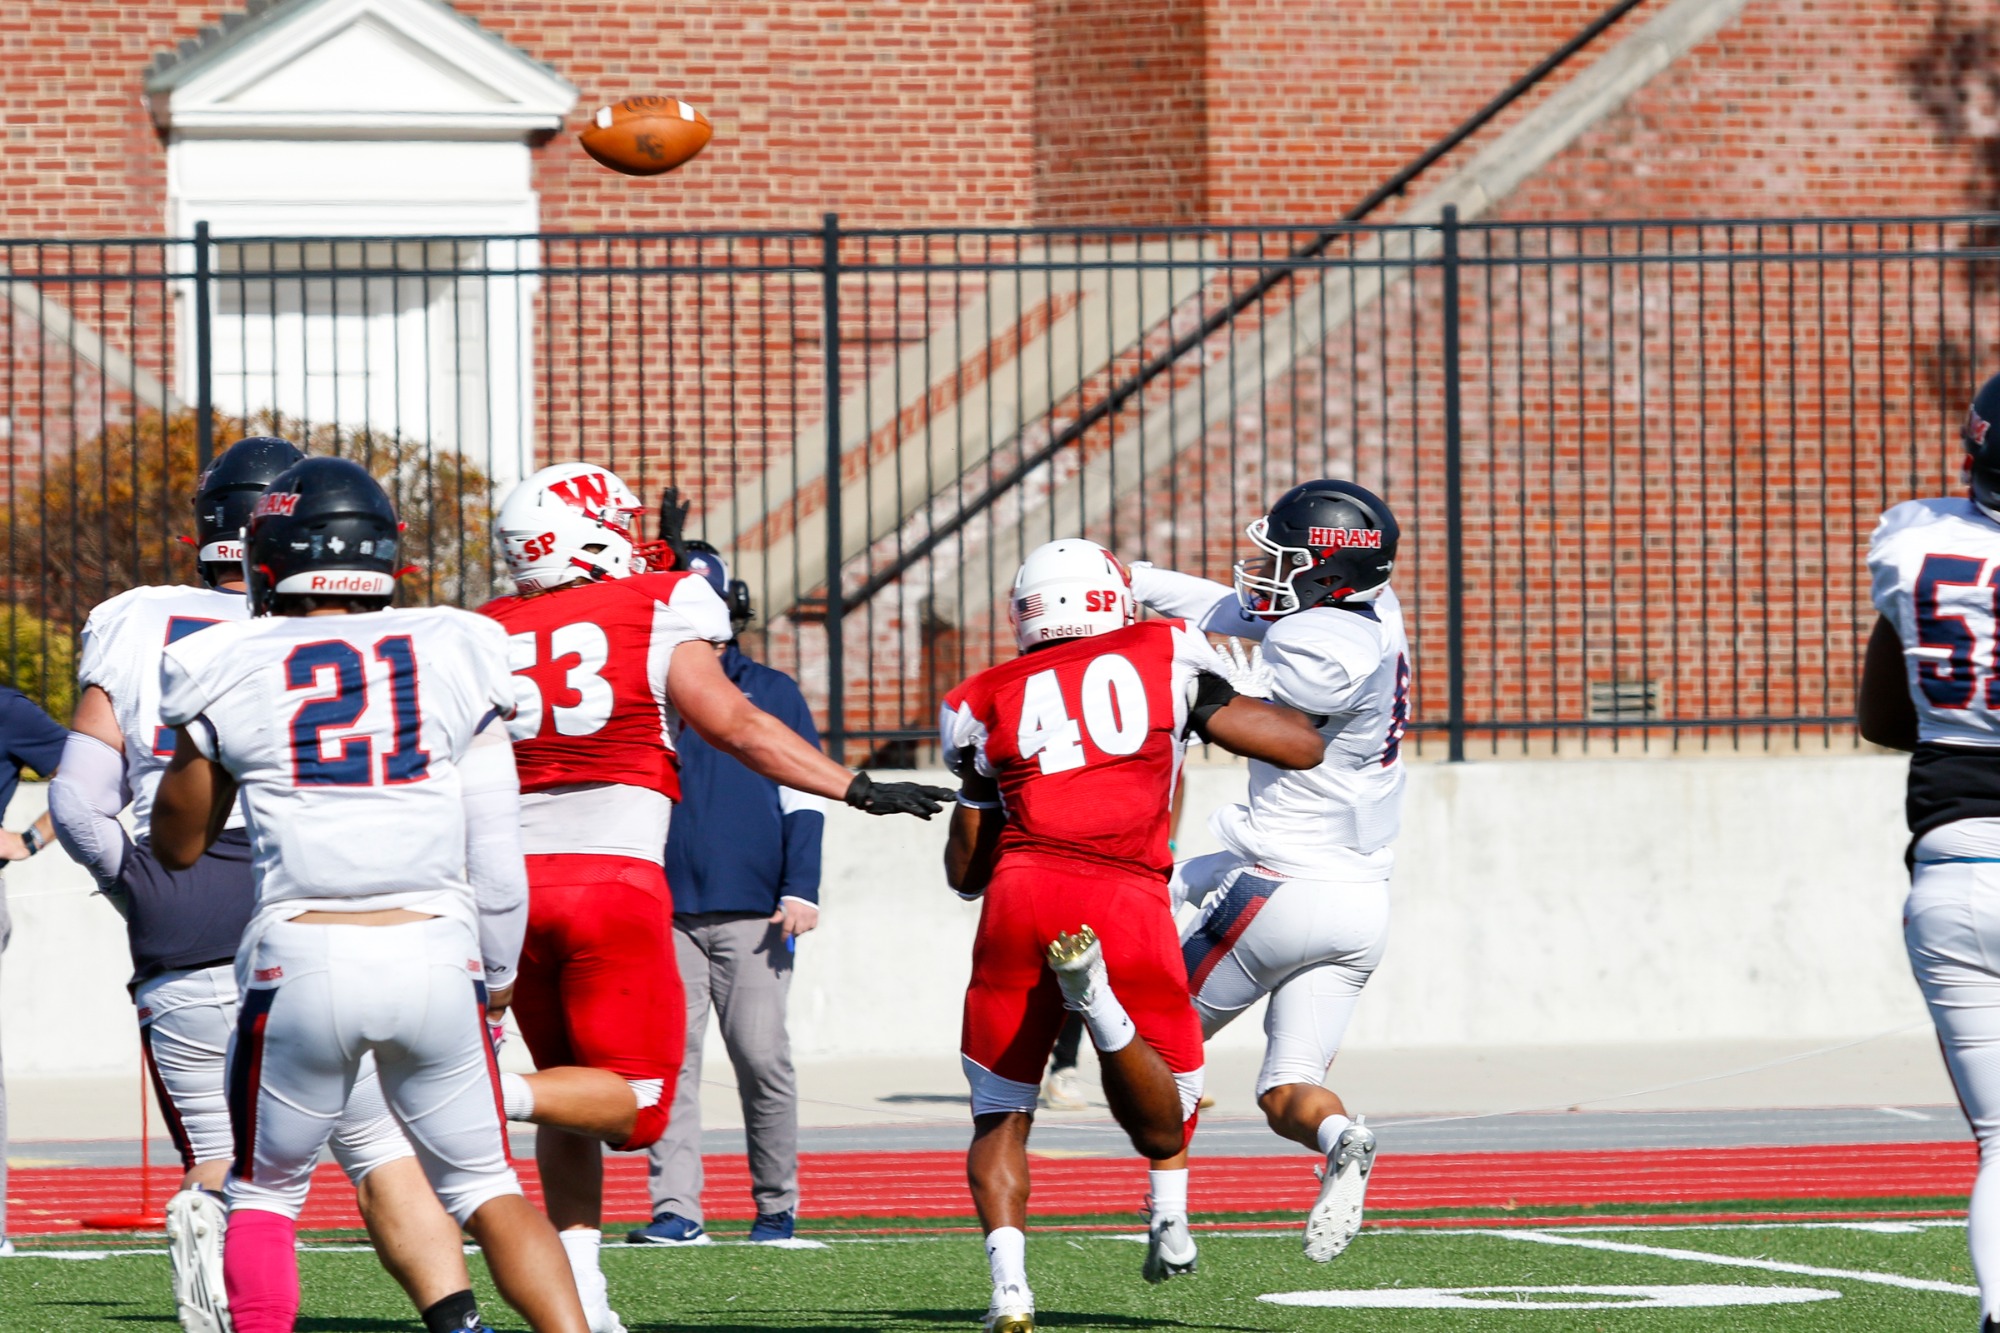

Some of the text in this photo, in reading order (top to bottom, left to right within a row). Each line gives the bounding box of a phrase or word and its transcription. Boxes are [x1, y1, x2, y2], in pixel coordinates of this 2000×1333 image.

[523, 532, 556, 562] SP
[1308, 526, 1382, 549] HIRAM
[311, 575, 383, 593] Riddell
[1085, 590, 1117, 612] SP
[1040, 624, 1093, 639] Riddell
[508, 621, 615, 743] 53
[283, 634, 430, 787] 21
[1017, 652, 1150, 776] 40
